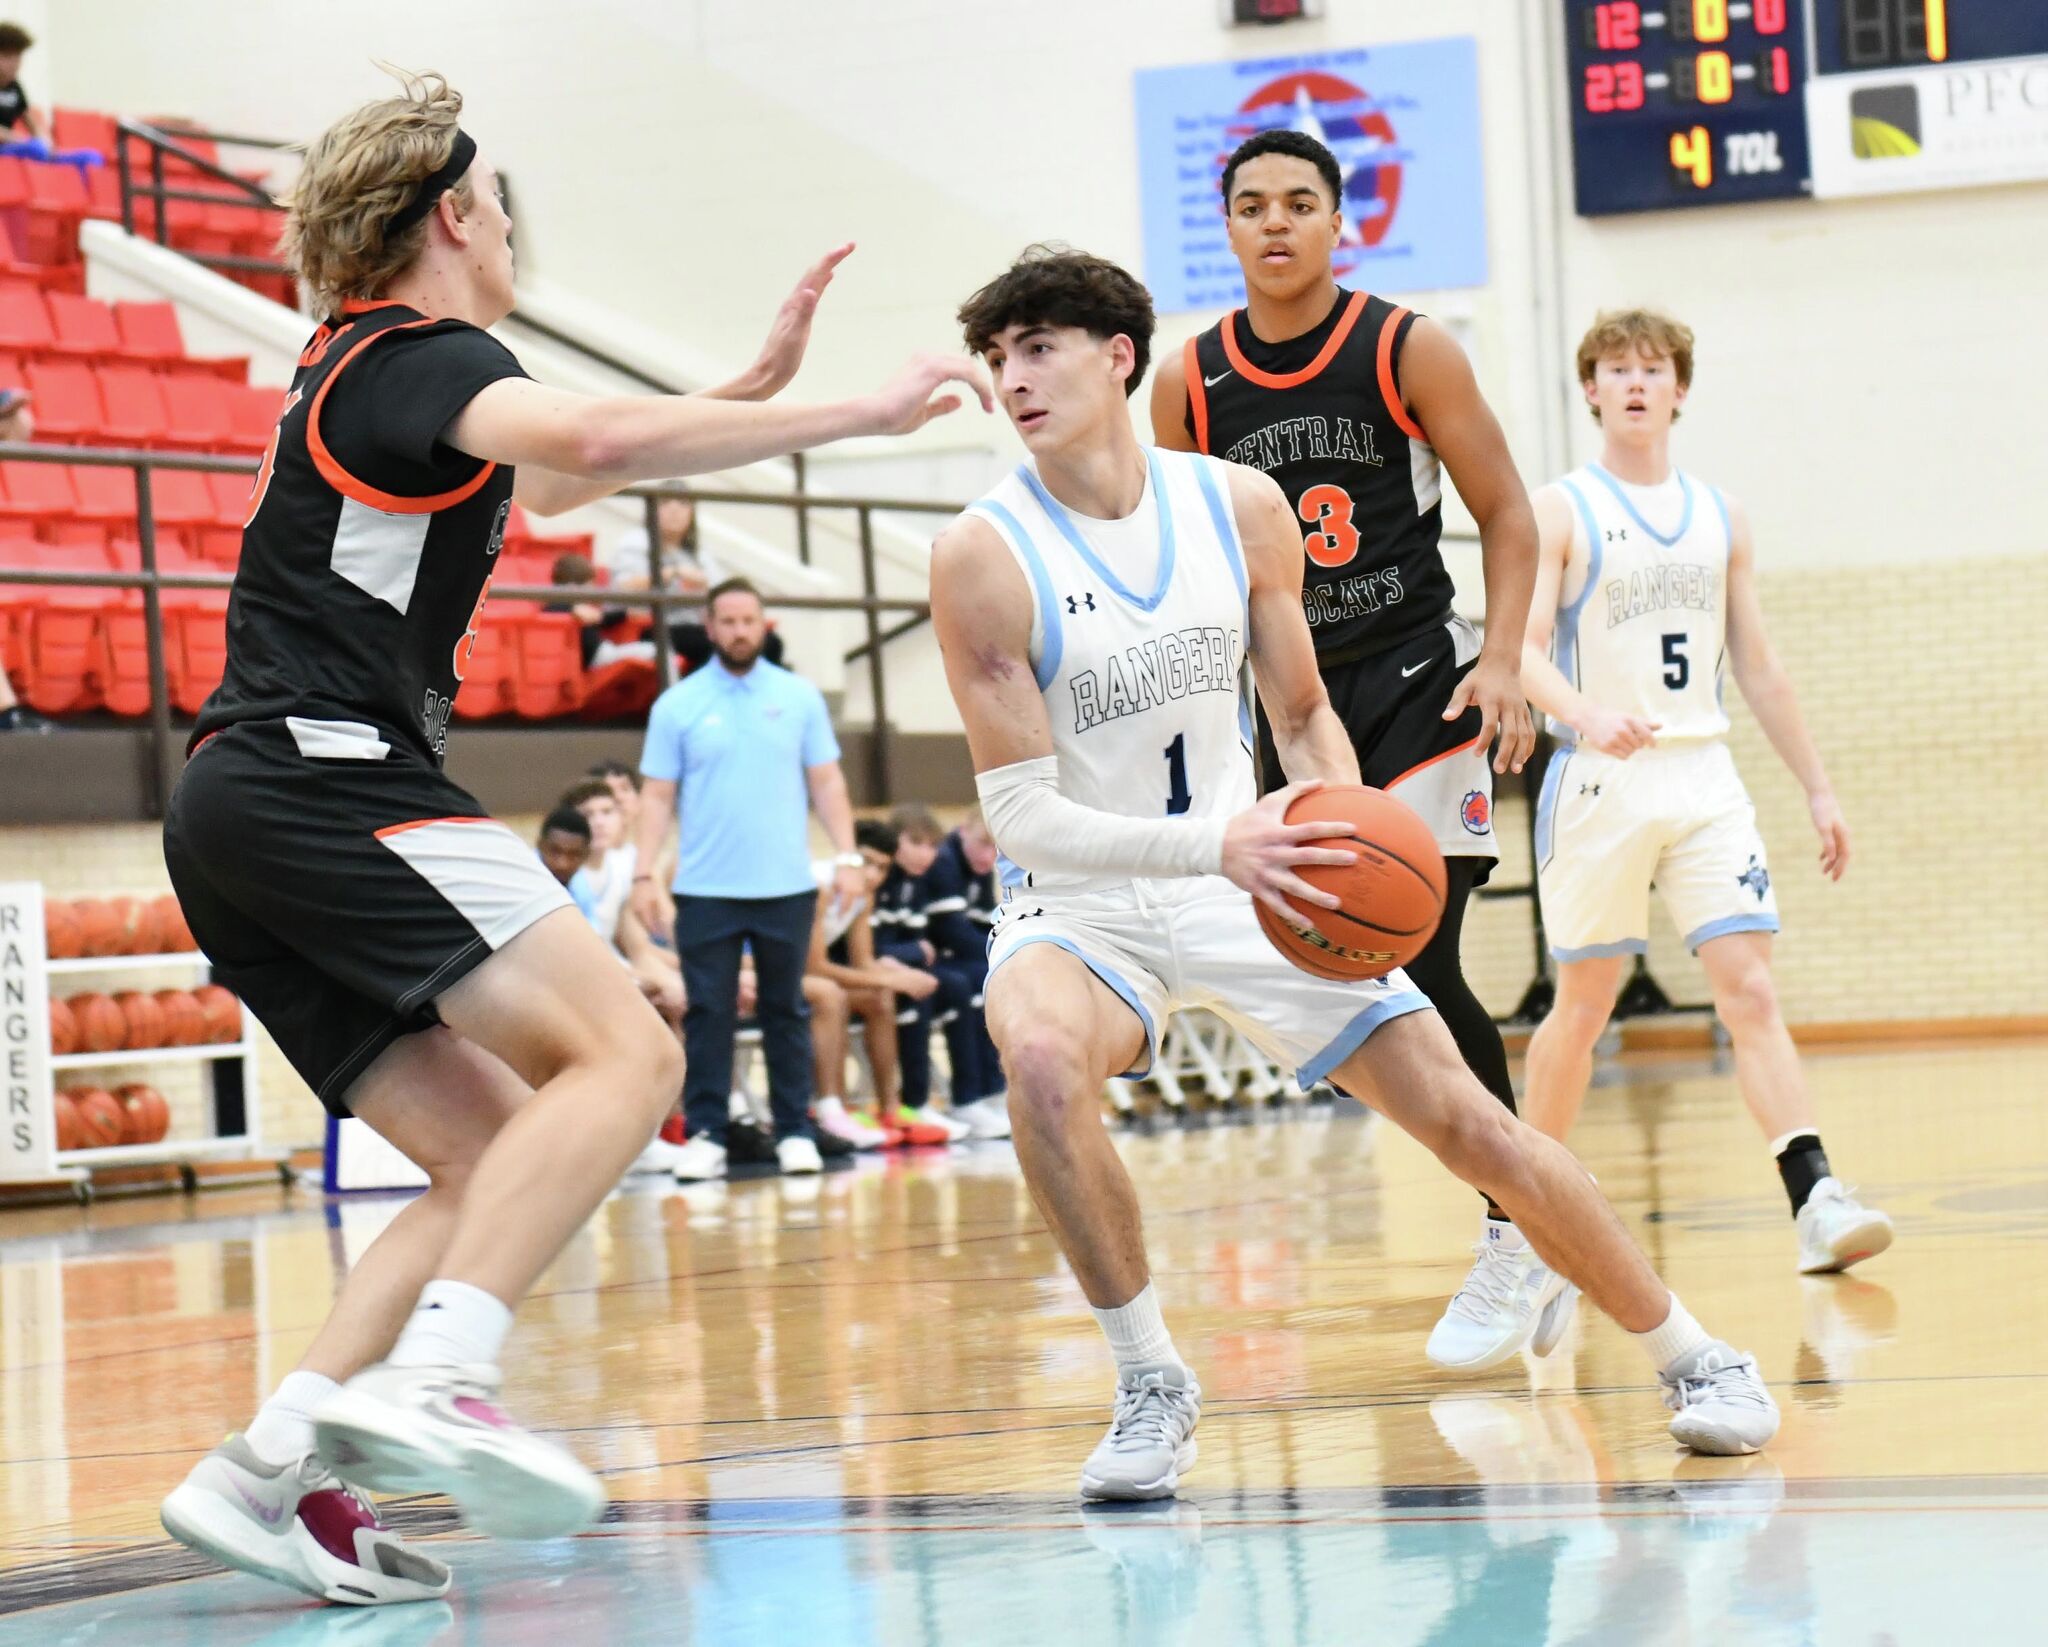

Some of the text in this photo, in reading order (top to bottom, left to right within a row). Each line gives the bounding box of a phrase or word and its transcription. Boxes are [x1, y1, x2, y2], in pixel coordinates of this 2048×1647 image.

[1596, 1, 1641, 49] 12
[1585, 47, 1791, 112] 23 0 1
[1669, 125, 1784, 188] 4 TOL
[1298, 483, 1362, 568] 3
[1301, 566, 1404, 627] BCATS
[1606, 563, 1717, 630] RANGER
[1661, 632, 1689, 690] 5
[1163, 732, 1193, 817] 1
[1, 904, 32, 1152] RANGERS
